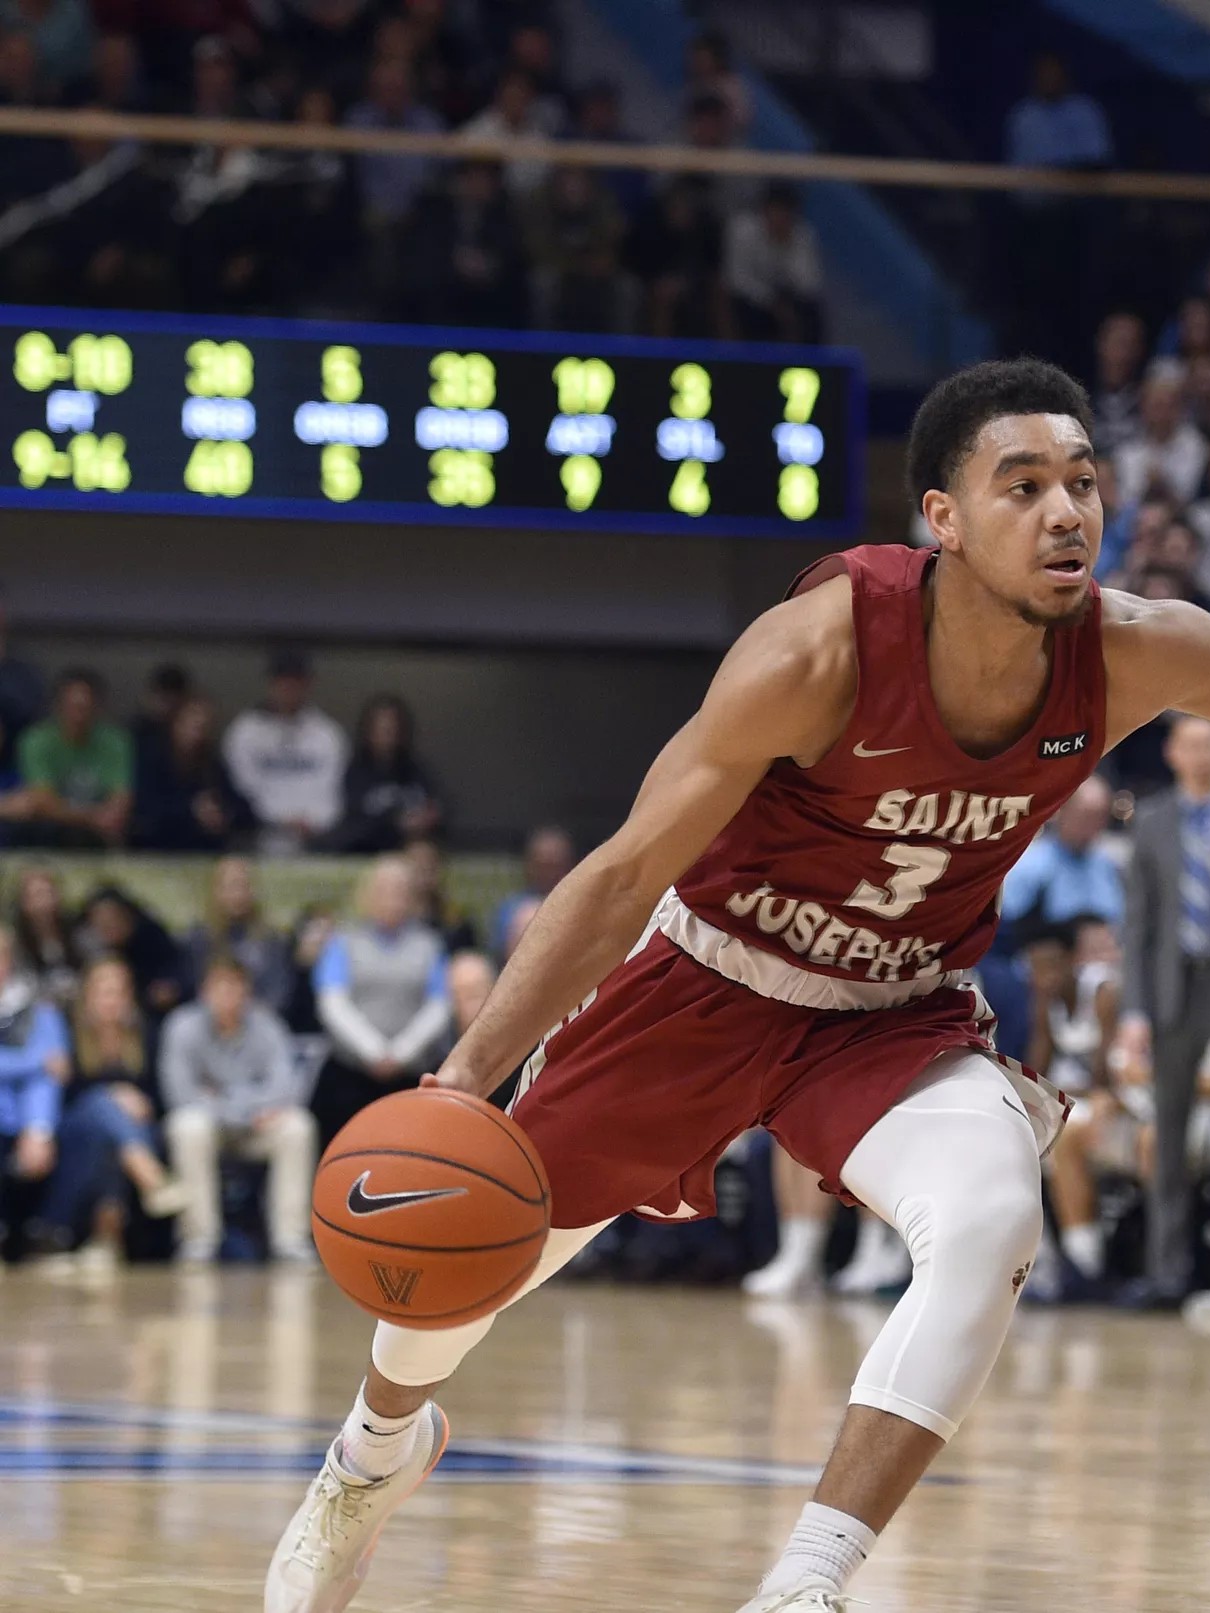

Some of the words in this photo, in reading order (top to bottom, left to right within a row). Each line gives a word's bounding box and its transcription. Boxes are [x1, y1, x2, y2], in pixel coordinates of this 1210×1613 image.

[779, 368, 820, 423] 7
[863, 788, 1033, 844] SAINT
[843, 842, 952, 920] 3
[725, 883, 947, 982] JOSEPH'S
[368, 1259, 424, 1305] V
